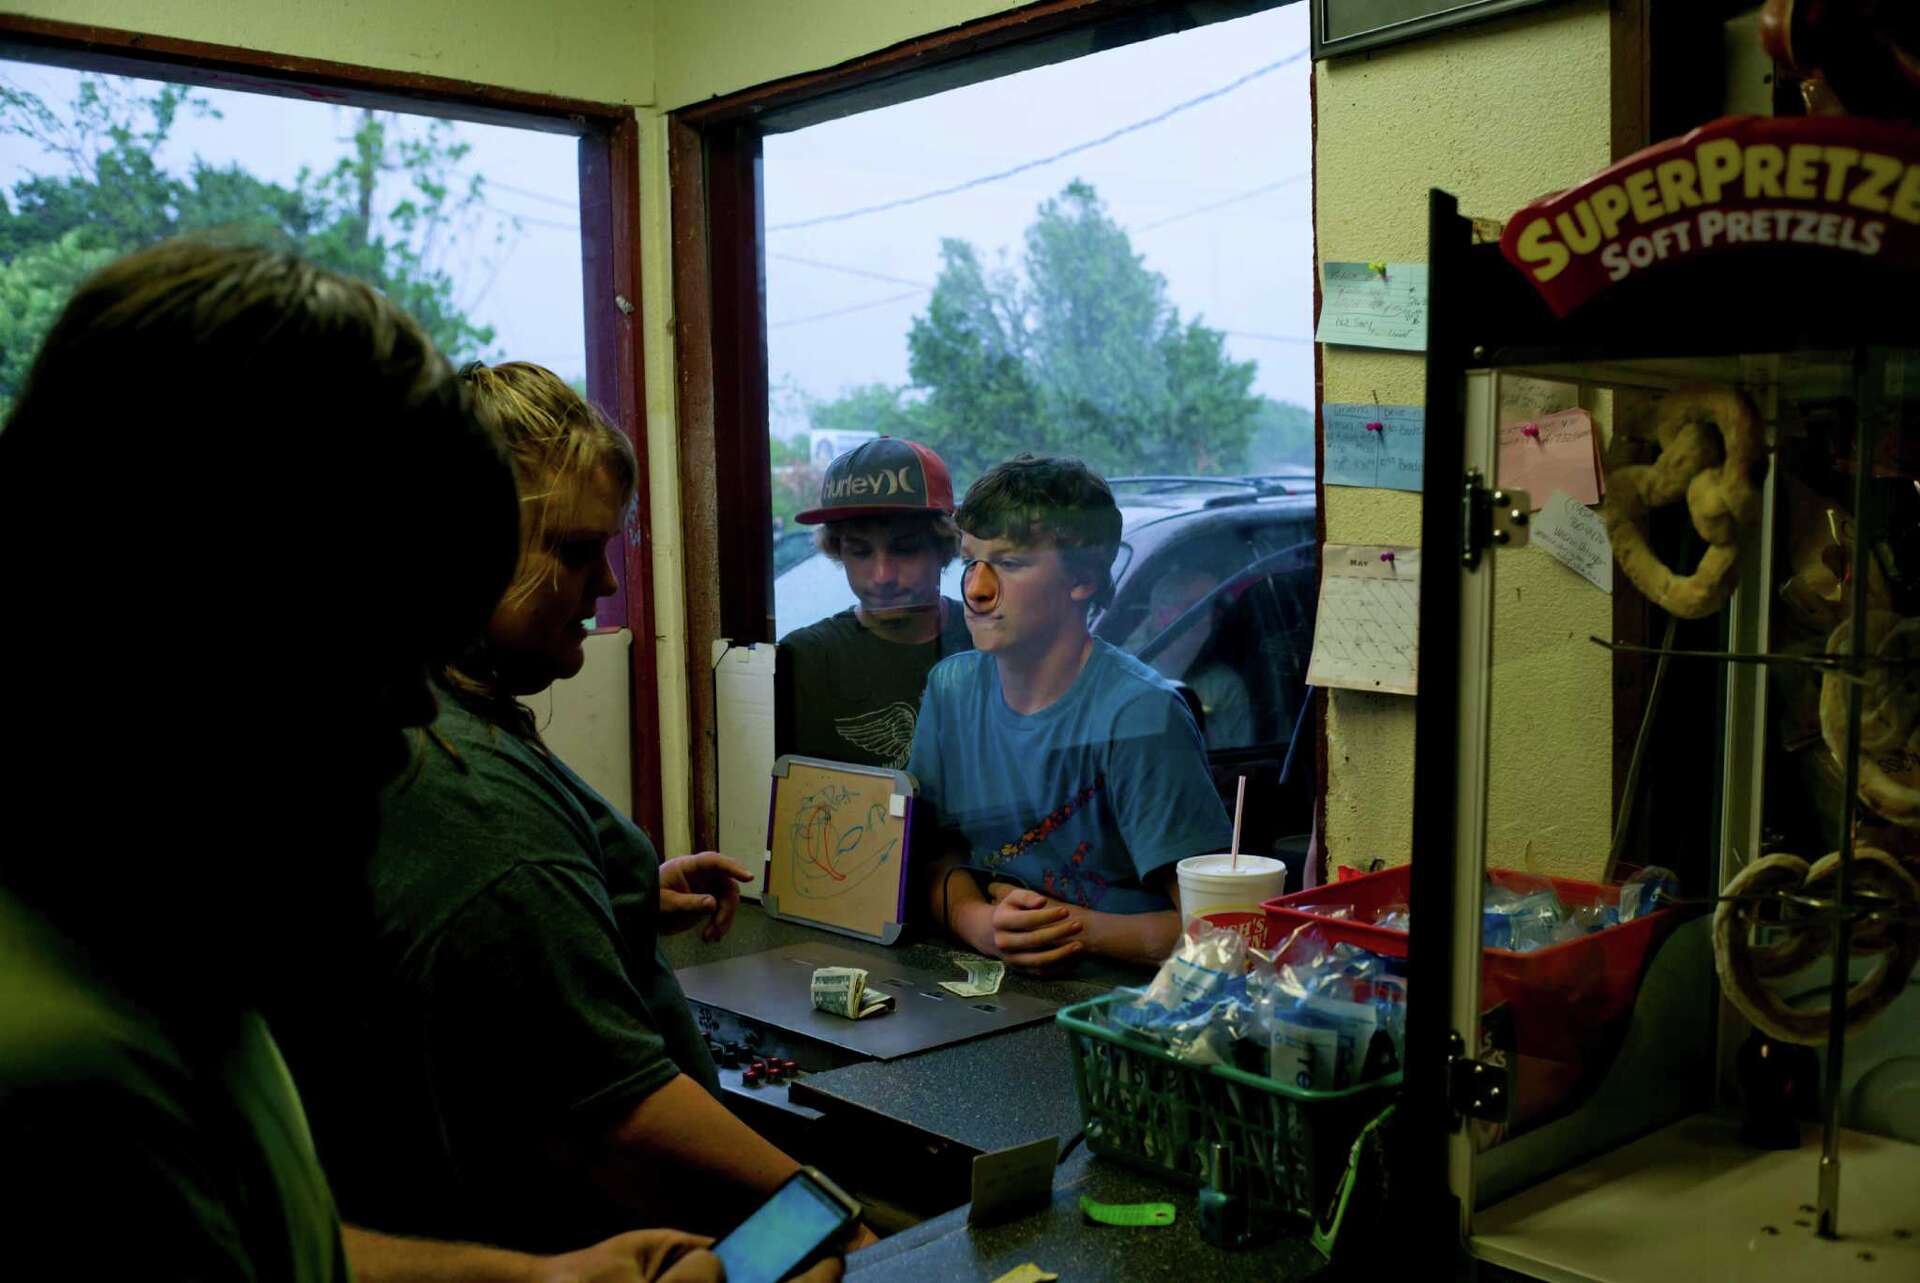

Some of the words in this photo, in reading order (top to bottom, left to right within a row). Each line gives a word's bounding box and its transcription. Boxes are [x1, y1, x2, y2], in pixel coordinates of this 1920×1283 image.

[1601, 220, 1692, 283] SOFT
[1700, 209, 1887, 256] PRETZELS
[1350, 559, 1369, 568] MAY
